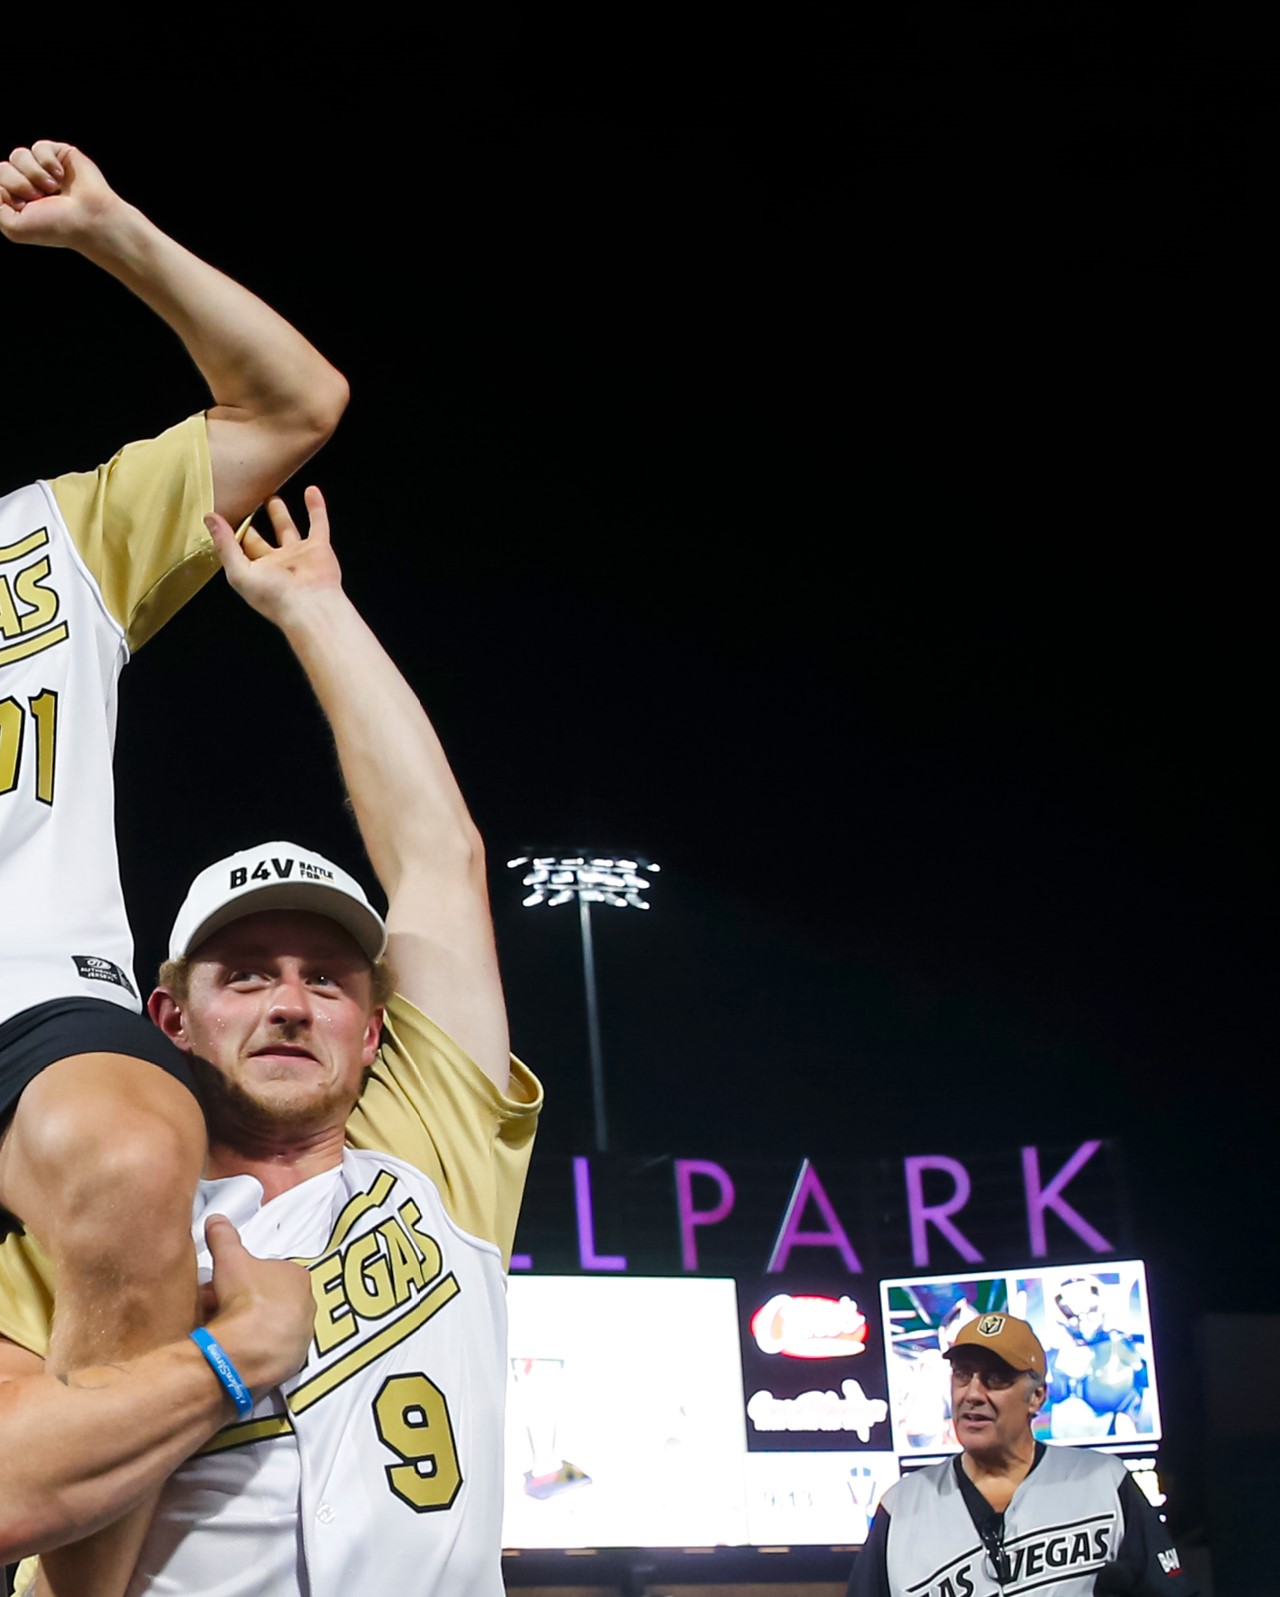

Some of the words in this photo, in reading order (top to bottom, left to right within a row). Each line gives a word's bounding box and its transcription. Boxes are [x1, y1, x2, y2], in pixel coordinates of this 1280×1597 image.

[230, 858, 294, 889] B4V
[299, 861, 334, 880] BATTLE
[300, 869, 320, 880] FOR
[510, 1140, 1114, 1274] LPARK
[308, 1197, 442, 1359] EGAS
[372, 1372, 463, 1513] 9
[1004, 1527, 1110, 1585] VEGAS
